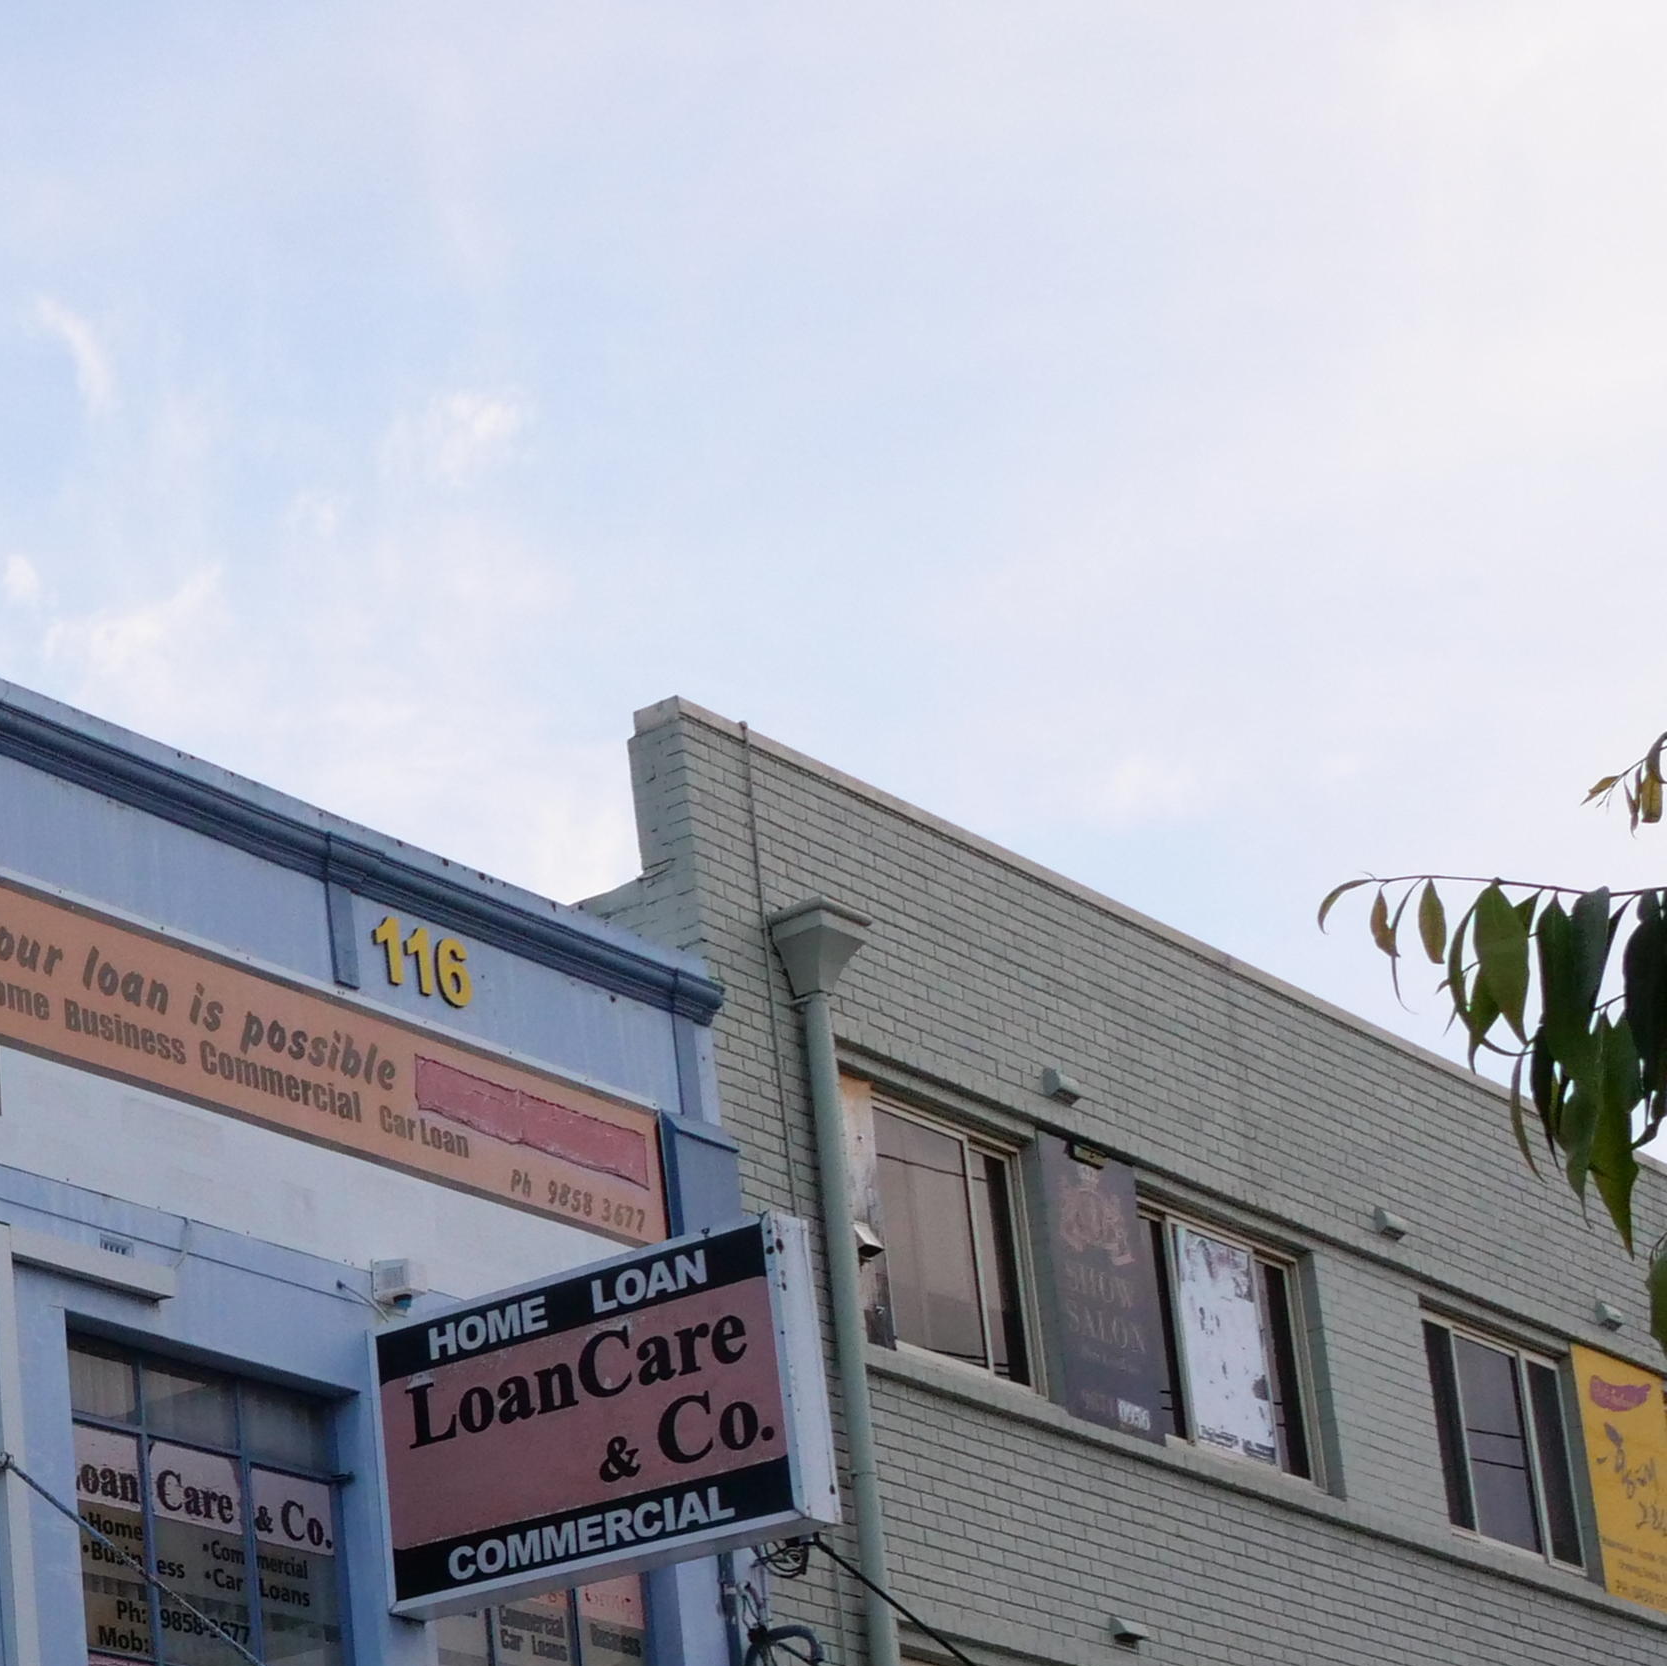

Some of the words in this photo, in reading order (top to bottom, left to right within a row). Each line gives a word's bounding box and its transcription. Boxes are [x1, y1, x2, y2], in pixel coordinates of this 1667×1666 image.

[373, 916, 472, 1008] 116
[83, 946, 169, 1015] loan
[189, 983, 224, 1032] is
[241, 1011, 396, 1090] possible
[65, 998, 186, 1065] Business
[199, 1040, 362, 1122] Commercial
[380, 1106, 415, 1142] Car
[421, 1119, 469, 1158] Loan
[511, 1169, 531, 1198] Ph
[548, 1180, 593, 1217] 9858
[428, 1296, 548, 1360] HOME
[590, 1249, 707, 1314] LOAN
[405, 1314, 748, 1449] LoanCare
[598, 1435, 641, 1482] &
[658, 1391, 775, 1464] Co.
[89, 1512, 143, 1540] Home
[156, 1469, 235, 1524] Care
[255, 1505, 273, 1533] &
[281, 1500, 333, 1550] Co.
[448, 1486, 735, 1581] COMMERCIAL
[214, 1569, 243, 1592] Car
[259, 1579, 310, 1606] Loans
[98, 1625, 149, 1652] Mob:
